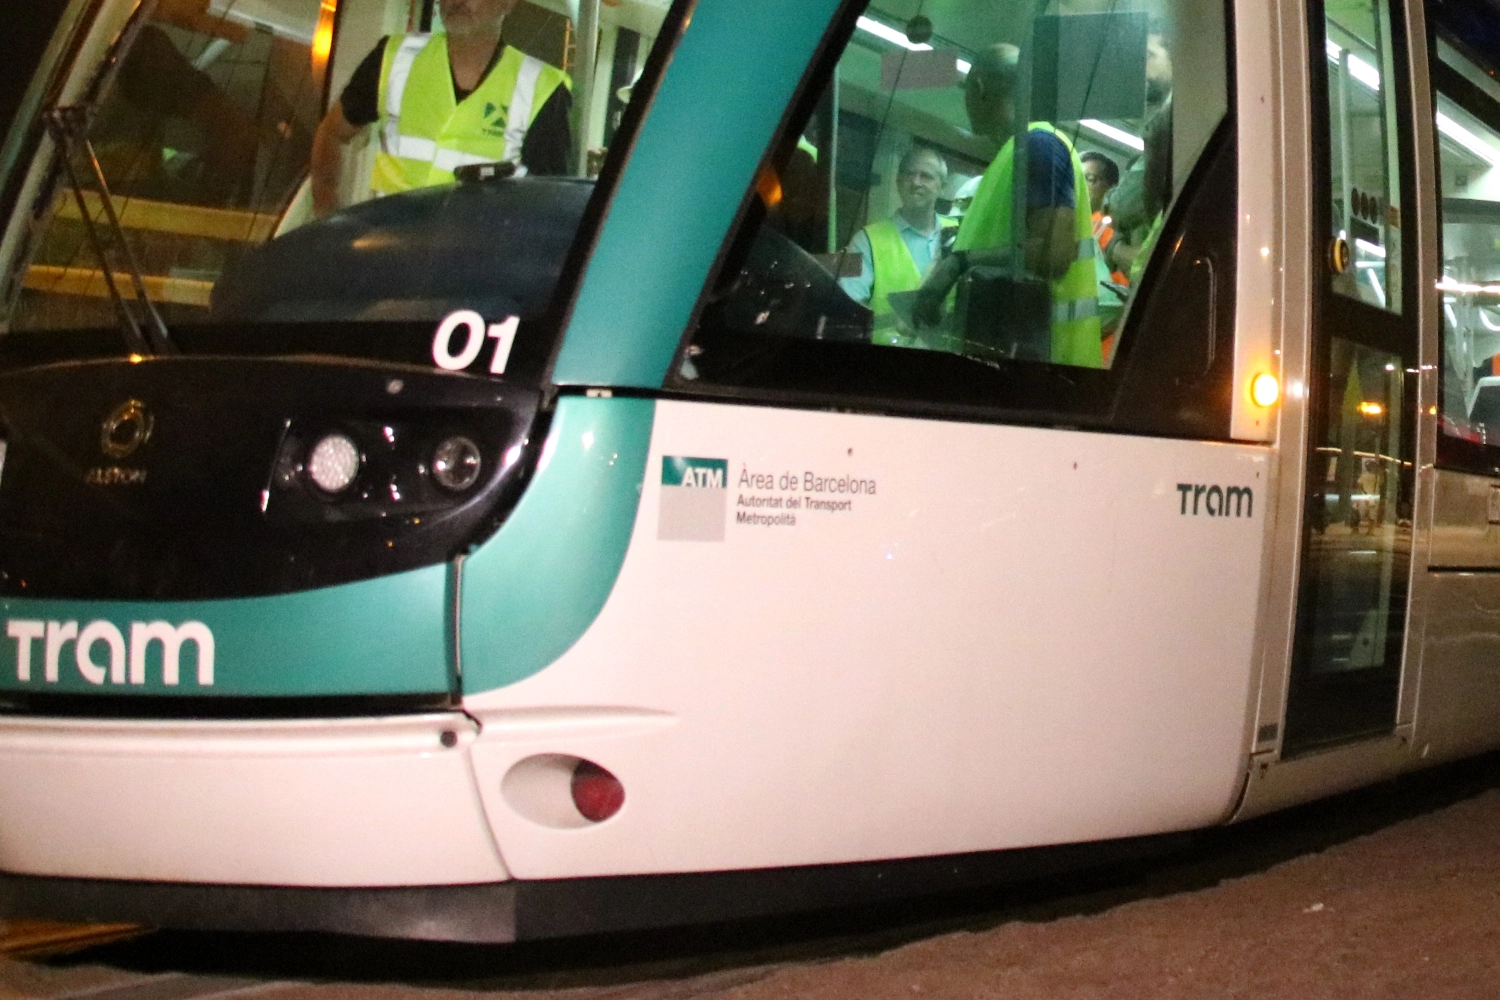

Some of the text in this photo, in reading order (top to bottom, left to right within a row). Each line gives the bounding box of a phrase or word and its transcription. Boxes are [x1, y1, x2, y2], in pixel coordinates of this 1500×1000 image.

[432, 309, 520, 375] 01
[682, 467, 724, 488] ATM
[779, 471, 798, 491] de
[803, 471, 877, 495] Barcelona
[737, 494, 852, 512] Autoritat del Transport
